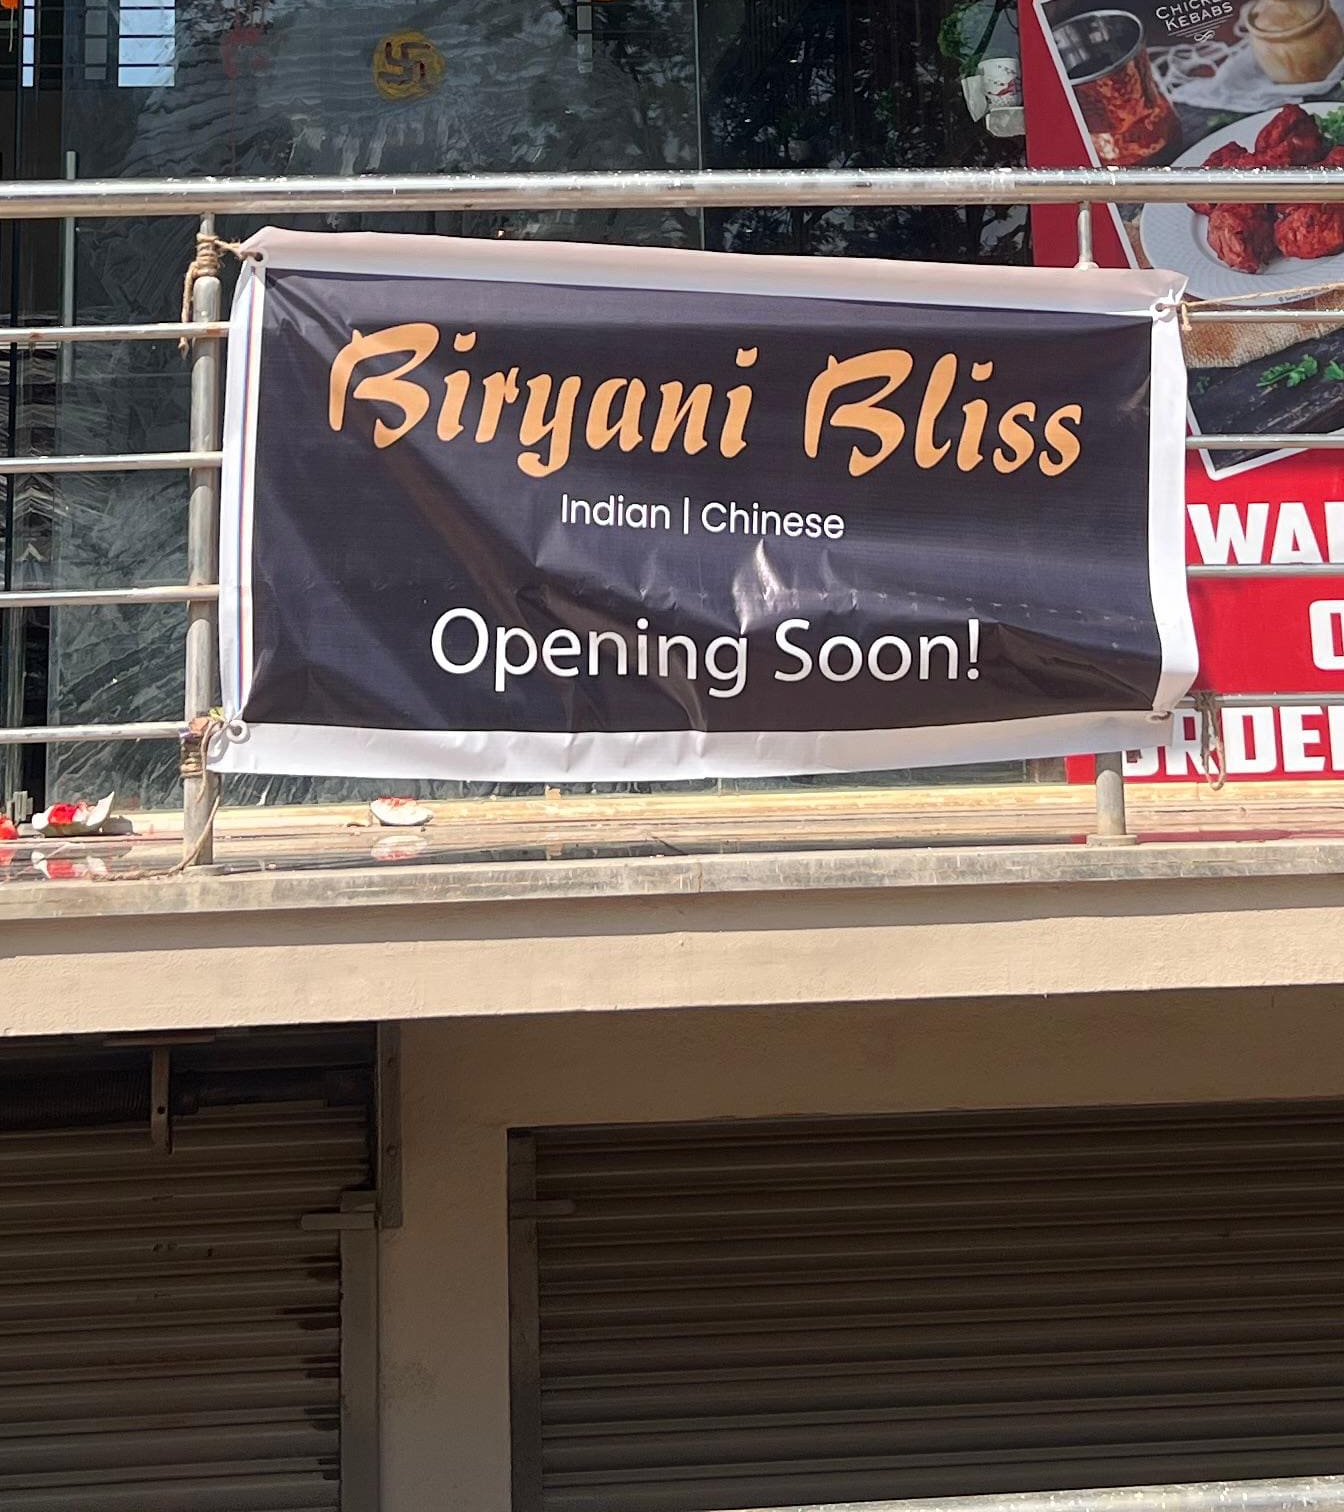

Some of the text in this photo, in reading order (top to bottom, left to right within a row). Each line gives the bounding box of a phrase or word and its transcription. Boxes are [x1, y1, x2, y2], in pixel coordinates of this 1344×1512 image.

[1164, 1, 1234, 31] KEBABS
[329, 322, 1083, 478] Biryani Bliss
[560, 494, 672, 531] Indian
[701, 500, 846, 539] Chinese
[430, 607, 981, 697] Opening Soon!
